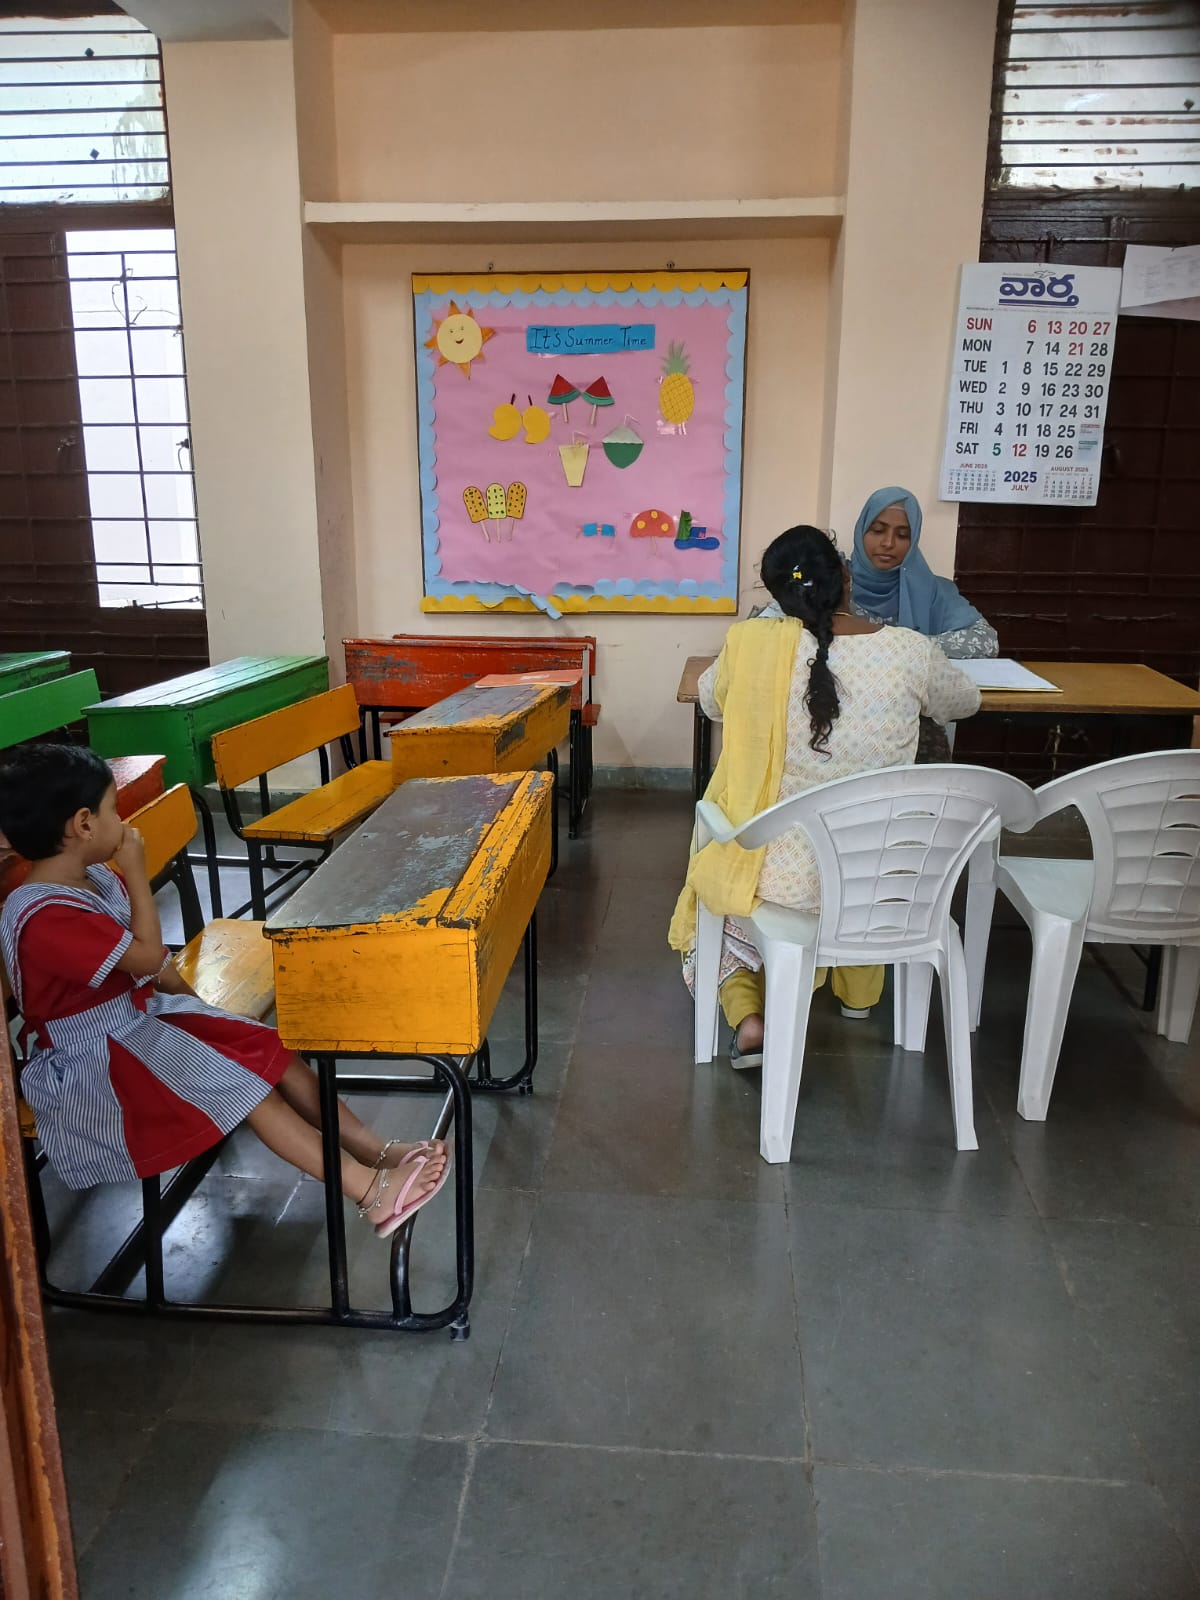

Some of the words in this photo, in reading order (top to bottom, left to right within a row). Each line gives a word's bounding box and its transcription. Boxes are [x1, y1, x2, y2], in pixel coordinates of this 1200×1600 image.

[999, 274, 1080, 307] వార్త
[967, 318, 992, 331] SUN
[1028, 320, 1036, 334] 6
[1048, 321, 1062, 335] 13
[1069, 322, 1087, 336] 20
[1093, 322, 1110, 336] 27
[529, 327, 562, 350] It's
[565, 327, 614, 348] Summer
[620, 326, 647, 347] Time
[963, 339, 991, 353] MON
[1027, 341, 1034, 355] 7
[1046, 342, 1059, 356] 14
[1068, 343, 1083, 356] 21
[1090, 343, 1107, 357] 28
[964, 360, 987, 373] TUE
[1003, 361, 1007, 375] 1
[1023, 362, 1031, 376] 8
[1043, 362, 1058, 376] 15
[1065, 363, 1082, 377] 22
[1087, 364, 1105, 378] 29
[960, 380, 987, 394] WED
[999, 382, 1006, 395] 2
[1022, 382, 1030, 396] 9
[1042, 383, 1056, 397] 16
[1062, 384, 1079, 398] 23
[1085, 384, 1103, 399] 30
[960, 401, 983, 414] THU
[996, 402, 1004, 416] 3
[1016, 403, 1031, 417] 10
[1040, 404, 1053, 417] 17
[1060, 404, 1077, 418] 24
[1084, 405, 1099, 419] 31
[960, 422, 978, 435] FRI
[994, 423, 1002, 437] 4
[1016, 424, 1027, 437] 11
[1037, 424, 1051, 438] 18
[1057, 425, 1075, 439] 25
[956, 442, 979, 455] SAT
[993, 443, 1001, 457] 5
[1013, 444, 1027, 457] 12
[1035, 445, 1049, 458] 19
[1056, 445, 1073, 459] 26
[1003, 470, 1037, 484] 2025
[1010, 484, 1030, 492] JULY
